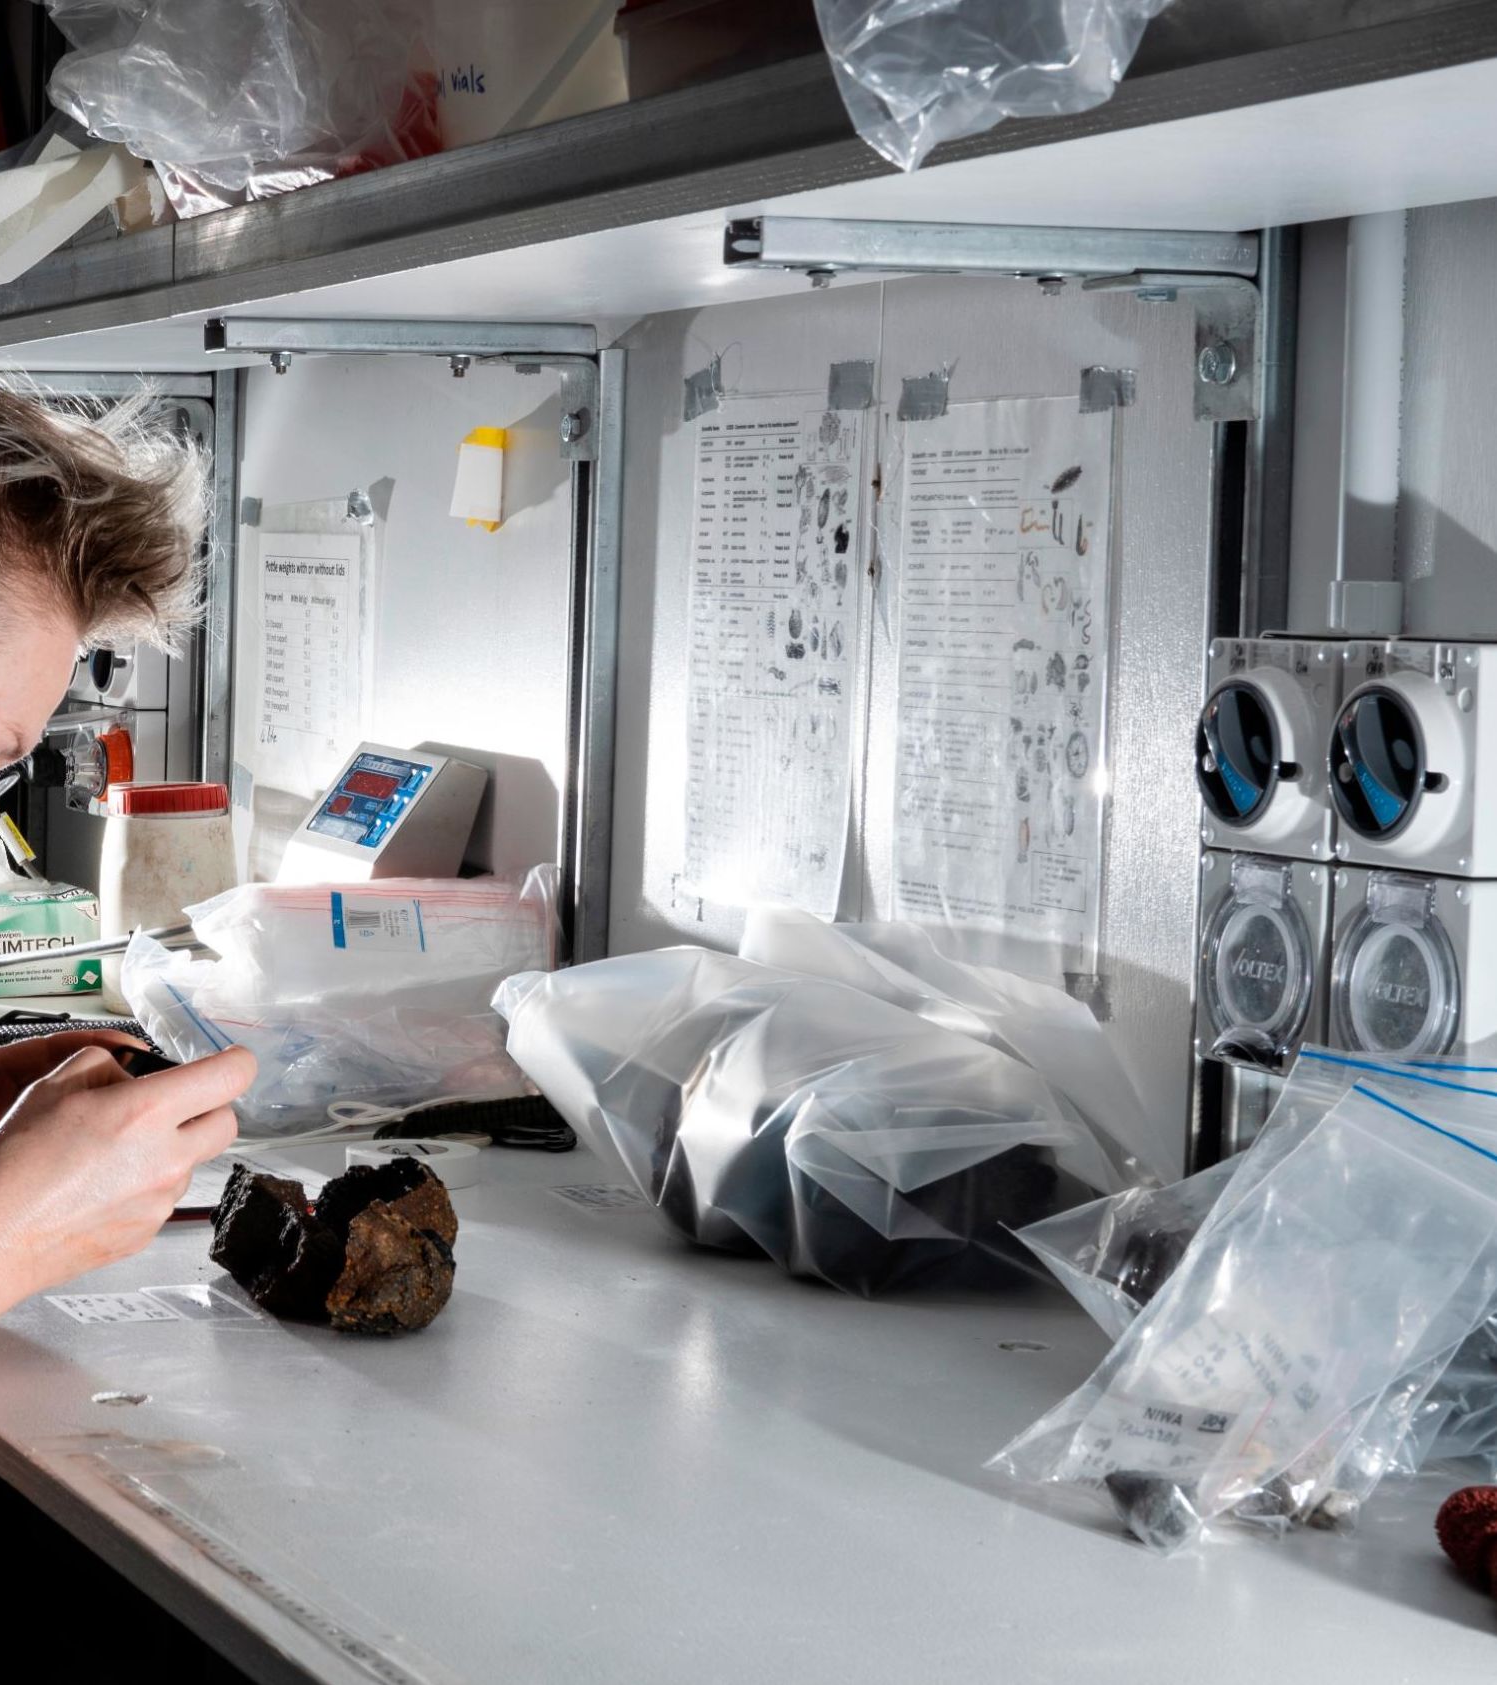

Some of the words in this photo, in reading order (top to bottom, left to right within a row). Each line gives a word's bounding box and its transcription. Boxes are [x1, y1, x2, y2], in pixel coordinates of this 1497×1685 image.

[451, 64, 485, 93] vials
[279, 561, 295, 576] weights
[297, 562, 307, 574] with
[309, 566, 314, 574] or
[315, 563, 334, 575] without
[336, 564, 345, 576] lids
[1231, 948, 1285, 983] VOLTEX
[62, 975, 78, 985] 280
[1370, 980, 1427, 1007] VOLTEX
[1143, 1407, 1183, 1426] NIWA
